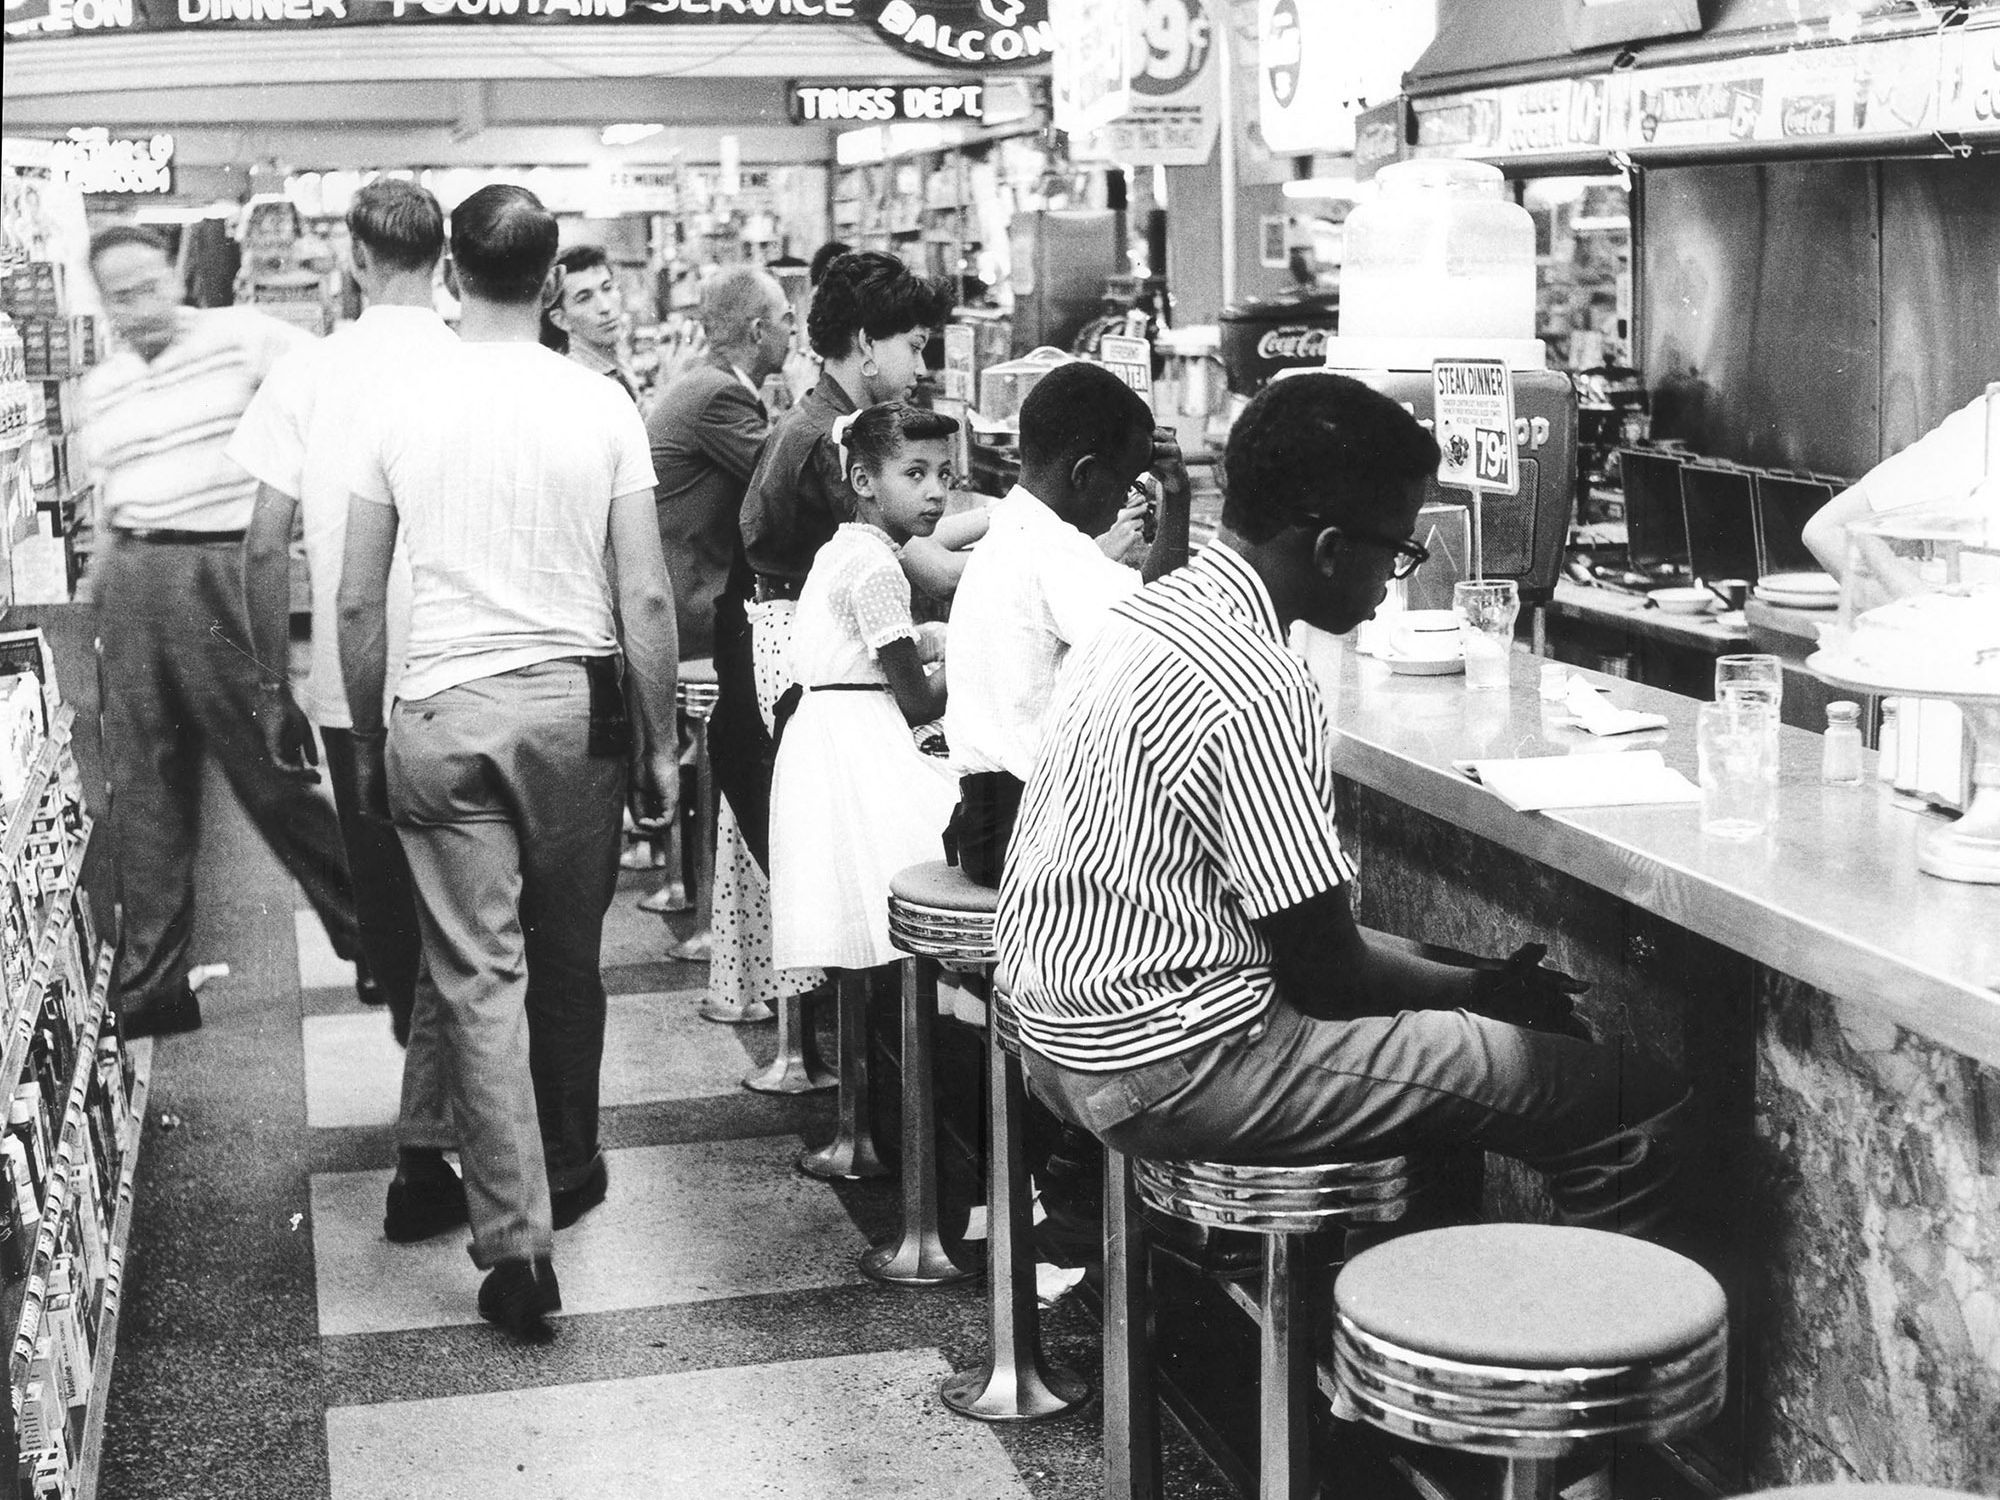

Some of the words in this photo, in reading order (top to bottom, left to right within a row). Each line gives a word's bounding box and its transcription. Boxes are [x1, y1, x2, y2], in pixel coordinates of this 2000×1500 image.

[178, 0, 348, 23] DINNER
[878, 0, 1053, 60] BALCON
[797, 87, 896, 120] TRUSS
[903, 85, 983, 119] DEPT
[1257, 325, 1338, 359] Coca-Co
[1438, 367, 1467, 395] STEAK
[1468, 367, 1505, 396] DINNER
